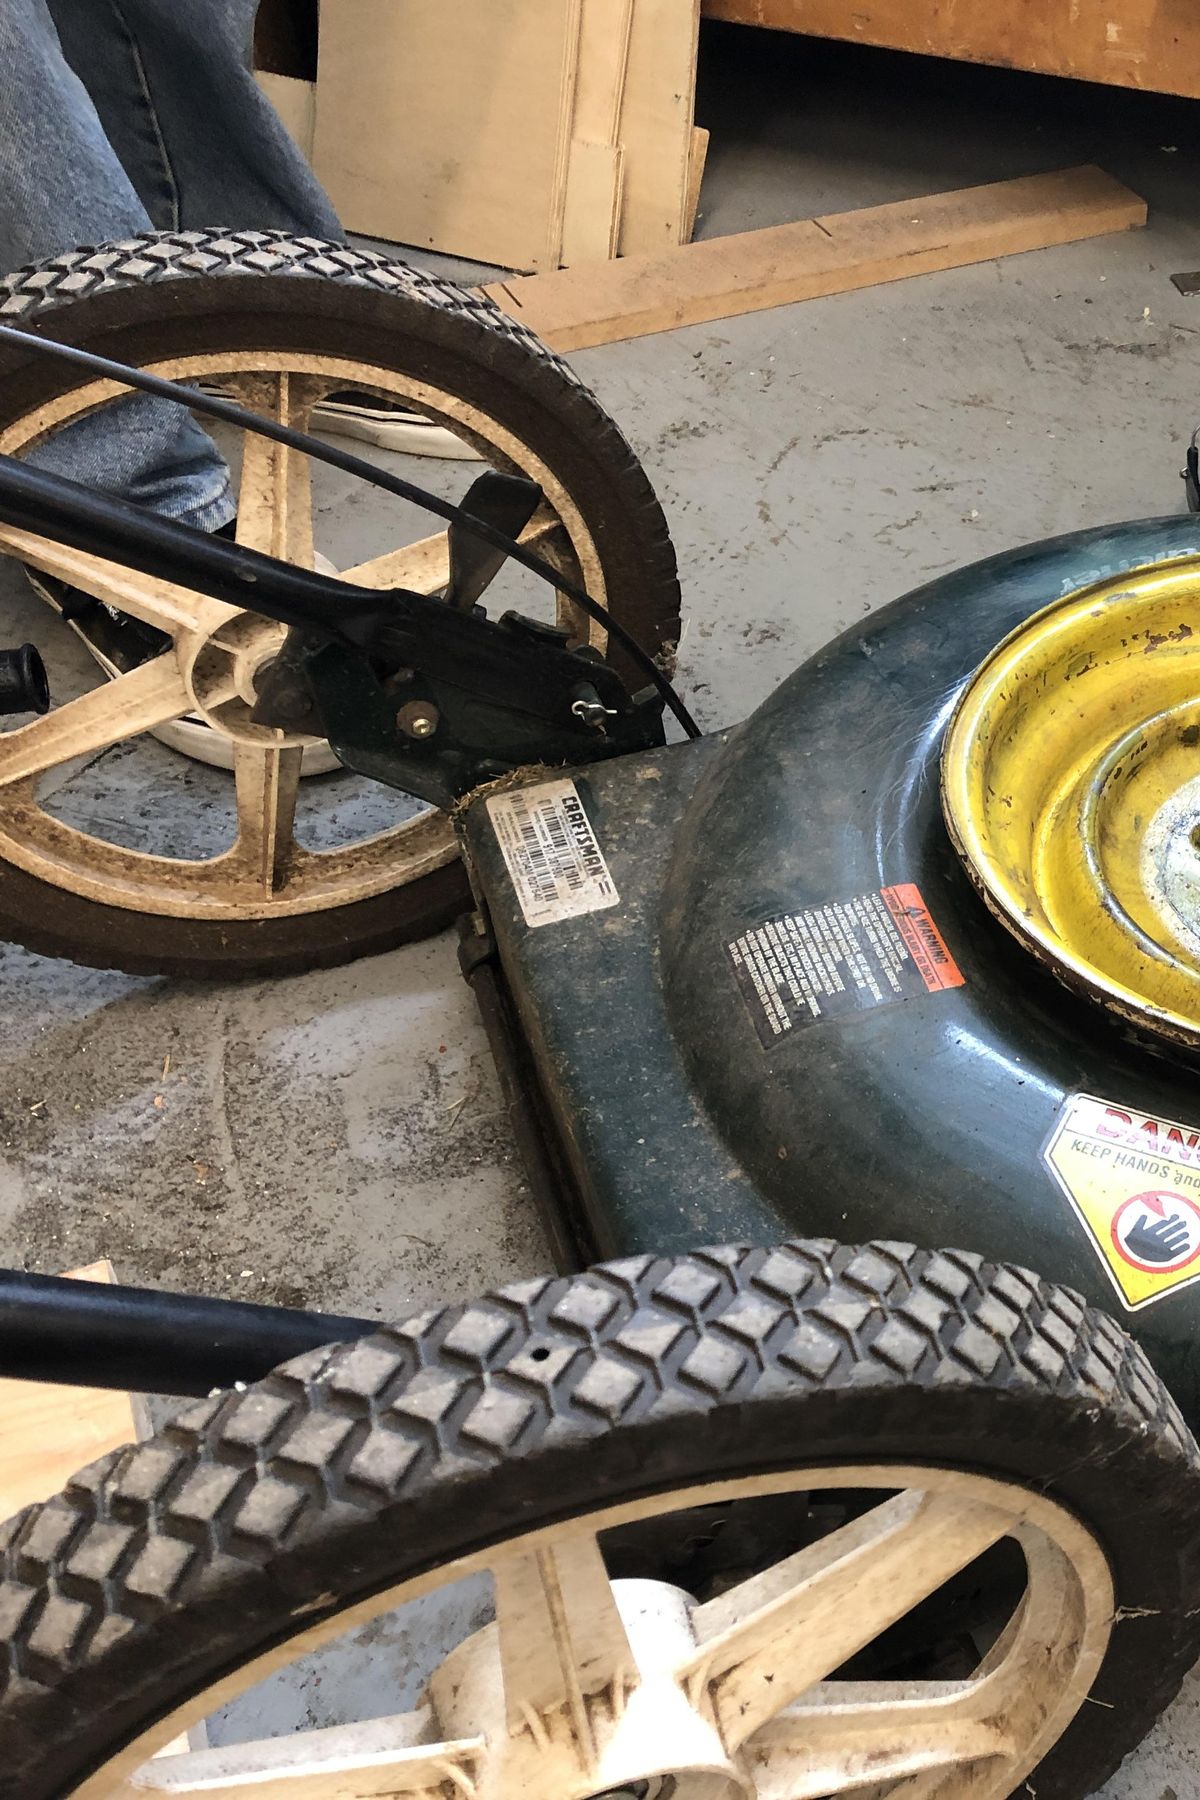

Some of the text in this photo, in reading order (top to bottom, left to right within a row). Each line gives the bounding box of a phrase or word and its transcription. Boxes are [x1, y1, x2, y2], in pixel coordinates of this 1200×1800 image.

[561, 796, 604, 877] CRAFTSMAN
[824, 907, 832, 916] DO
[869, 911, 878, 921] THE
[795, 915, 804, 927] AND
[746, 932, 754, 941] DO
[823, 929, 832, 941] ARE
[853, 901, 861, 910] THE
[880, 957, 889, 968] THE
[916, 917, 948, 965] WARNING
[728, 942, 735, 951] IN
[749, 940, 758, 951] NOT
[785, 918, 795, 931] KEEP
[790, 930, 802, 949] SAFETY
[798, 948, 811, 970] DEVICES
[764, 949, 773, 958] BY
[790, 955, 797, 963] IN
[753, 949, 768, 974] OPERATE
[767, 957, 777, 968] THE
[856, 952, 866, 965] NOT
[861, 963, 869, 972] UP
[773, 944, 788, 967] OBJECTS
[783, 965, 793, 980] THAT
[788, 979, 801, 998] COULD
[792, 961, 804, 979] PLACE
[921, 964, 935, 984] DEATH
[743, 953, 756, 972] GRASS
[763, 1002, 773, 1014] THE
[799, 978, 809, 990] AND
[771, 992, 786, 1017] WITHOUT
[781, 1017, 791, 1030] THE
[1070, 1138, 1111, 1159] KEEP
[1114, 1152, 1170, 1179] HANDS
